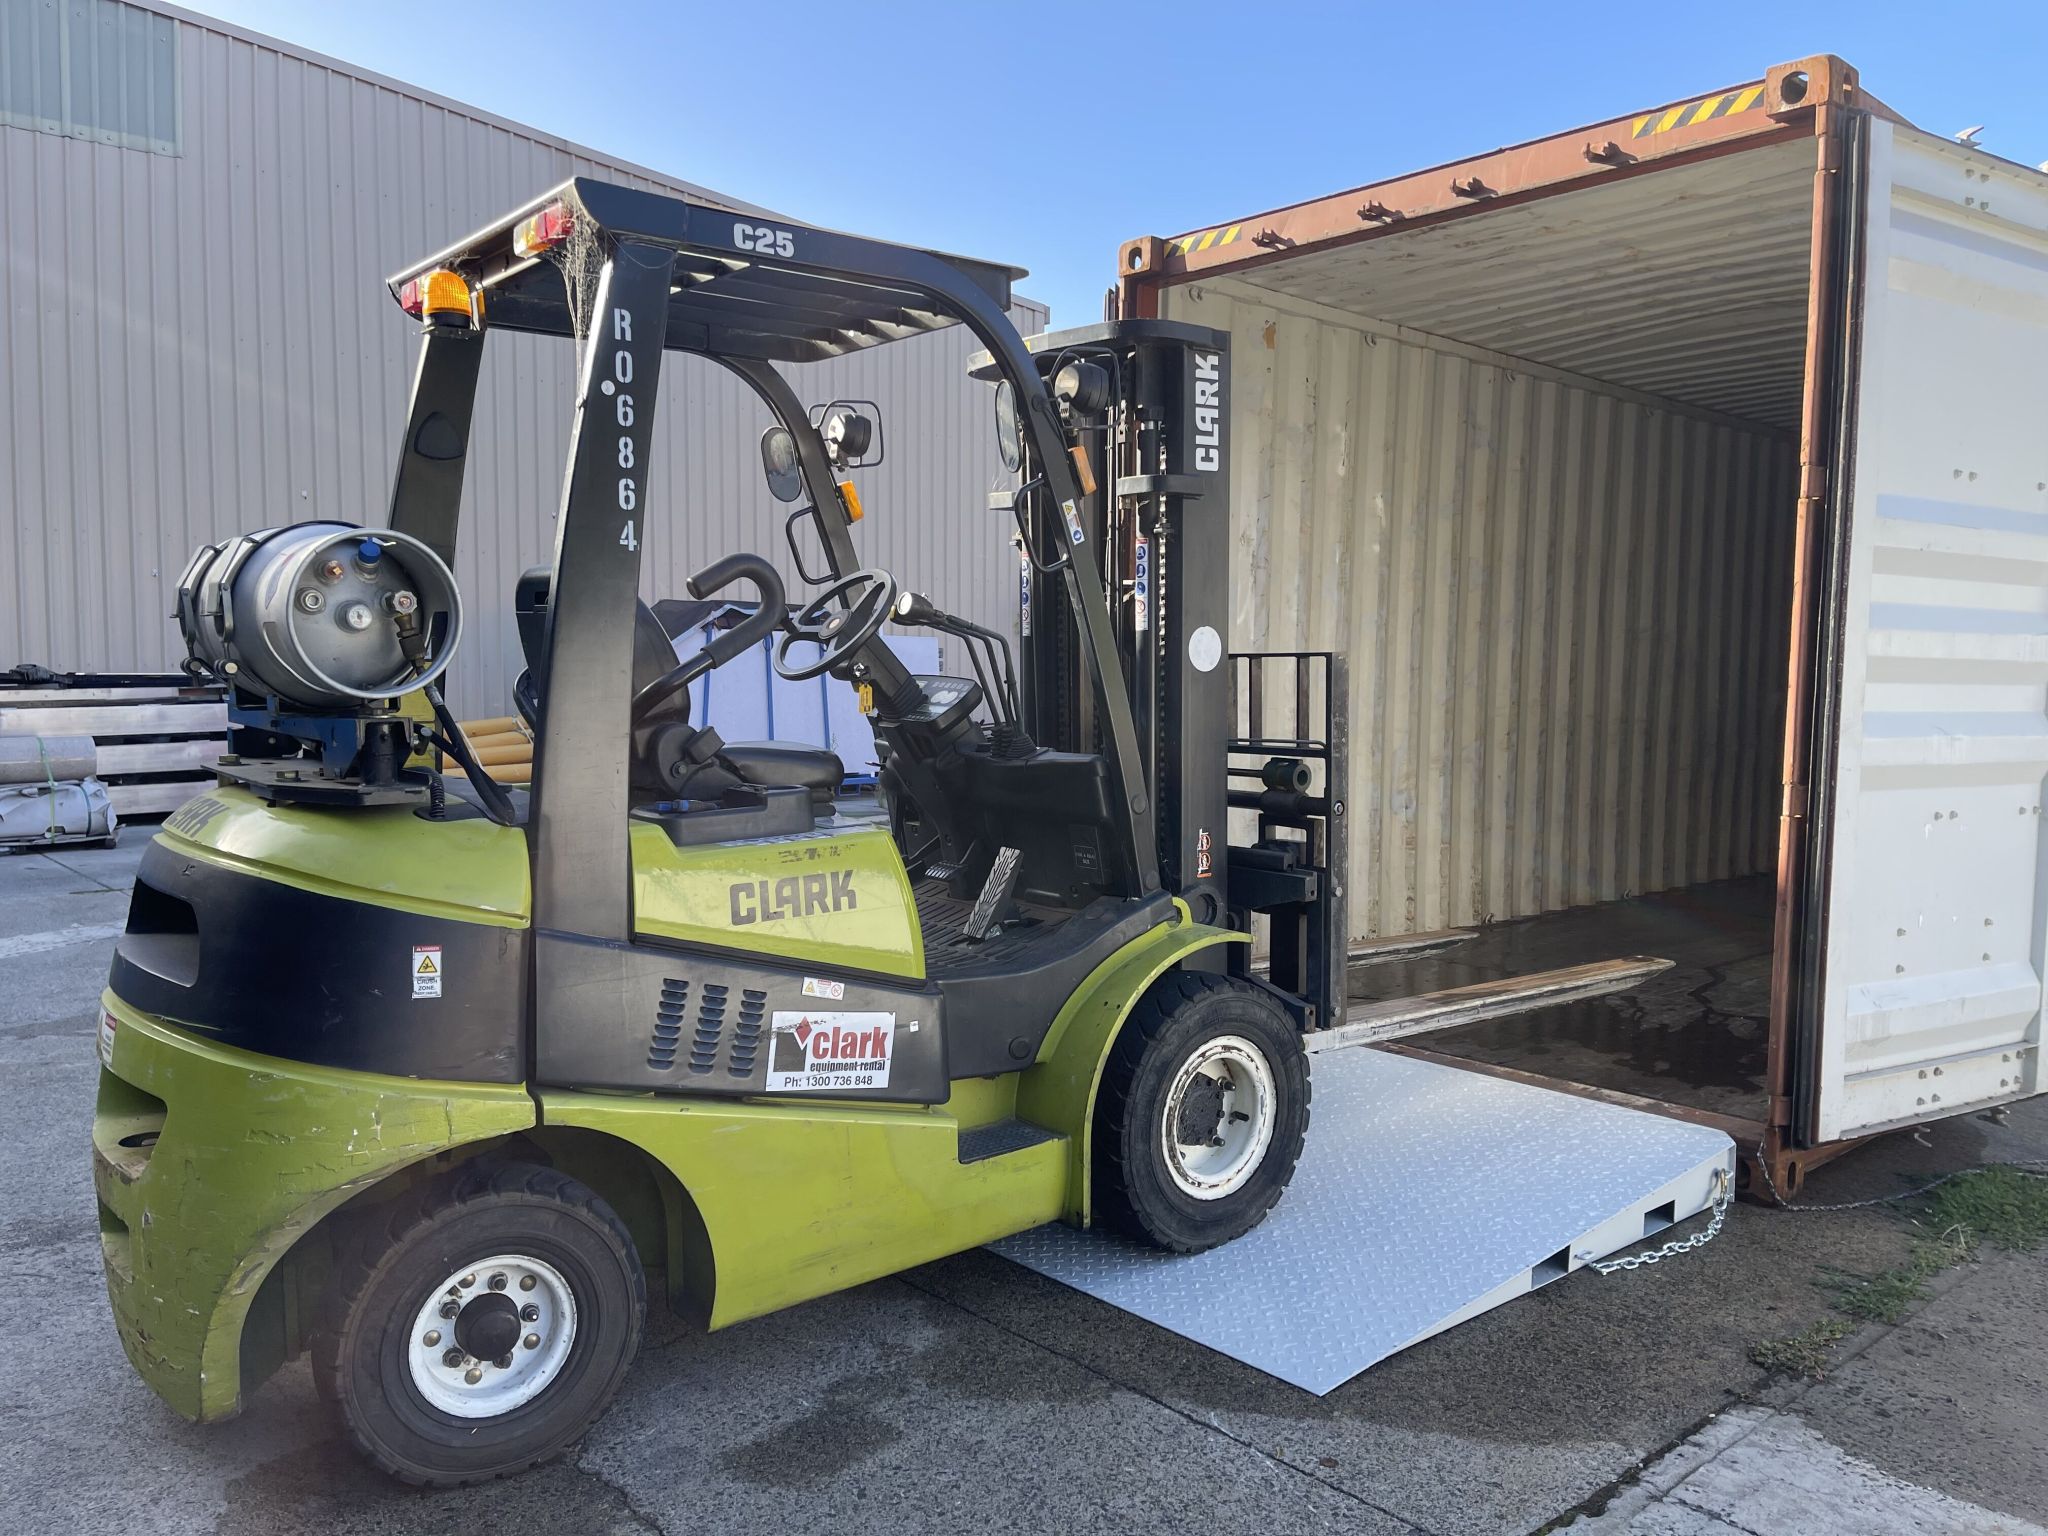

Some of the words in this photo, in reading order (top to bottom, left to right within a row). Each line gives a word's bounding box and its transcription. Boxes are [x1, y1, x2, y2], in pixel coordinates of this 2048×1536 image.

[733, 223, 795, 258] C25
[1195, 353, 1219, 472] CLARK
[729, 869, 857, 926] CLARK
[812, 1026, 888, 1059] clark
[784, 1076, 802, 1087] Ph:
[806, 1076, 831, 1087] 1300
[833, 1075, 852, 1086] 736
[854, 1075, 873, 1086] 848
[810, 1061, 857, 1073] equipment
[860, 1060, 885, 1071] rental
